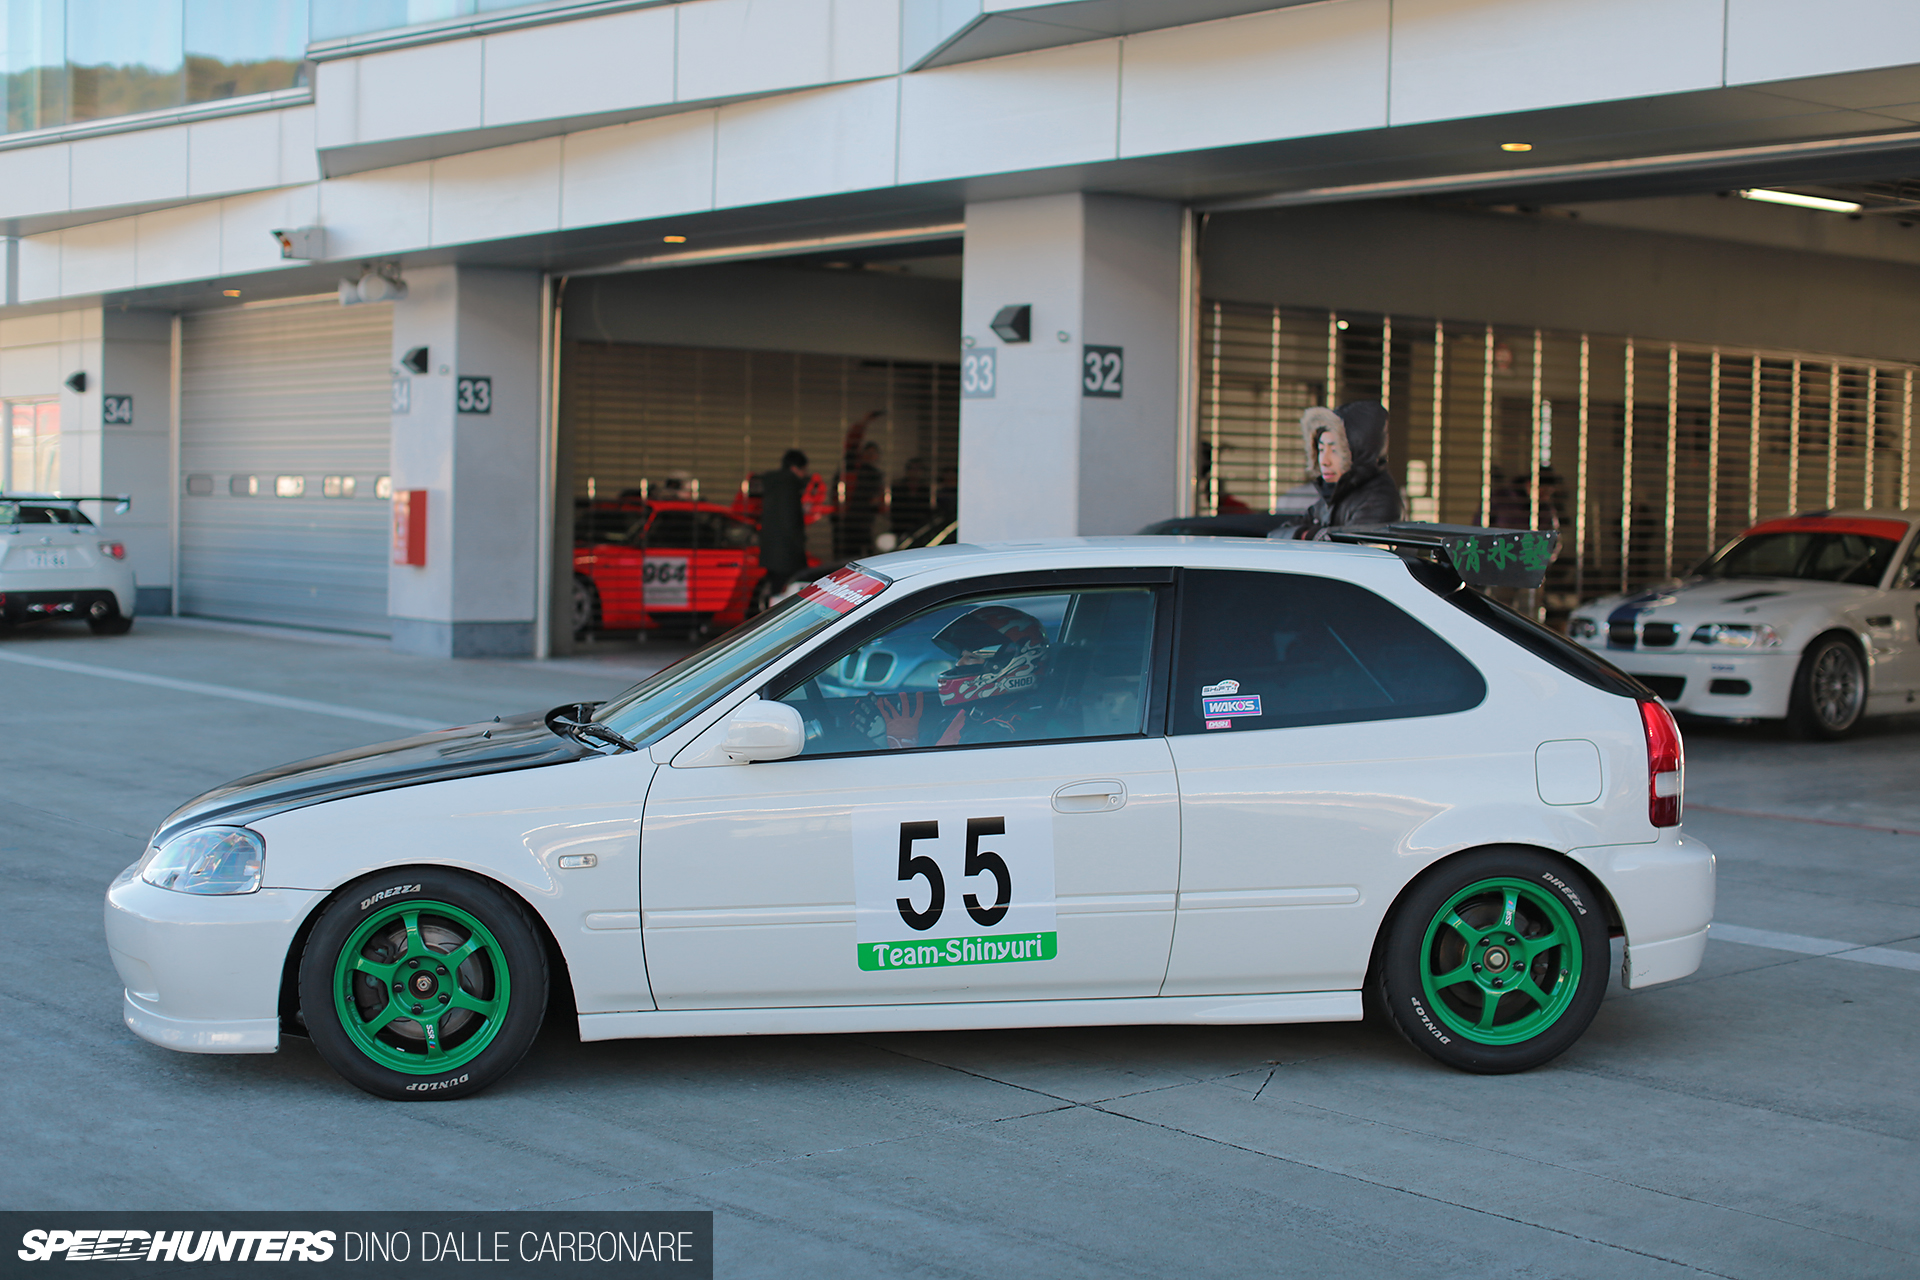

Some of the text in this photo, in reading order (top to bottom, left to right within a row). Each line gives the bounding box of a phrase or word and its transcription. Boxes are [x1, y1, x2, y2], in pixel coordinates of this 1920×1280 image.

[963, 355, 993, 393] 33
[1084, 351, 1121, 392] 32
[458, 380, 490, 412] 33
[104, 398, 130, 423] 34
[643, 562, 687, 584] 964
[1008, 676, 1033, 689] SHOEI
[1208, 720, 1229, 729] DASH
[896, 816, 1012, 931] 55
[360, 883, 421, 910] DIREZZA
[1541, 872, 1588, 916] DIREZZA
[1504, 910, 1512, 926] SSR
[873, 934, 1043, 967] Team-Shinyuri
[426, 1024, 435, 1039] SSR
[1411, 996, 1451, 1045] DUNLOP
[406, 1073, 469, 1092] DUNLOP
